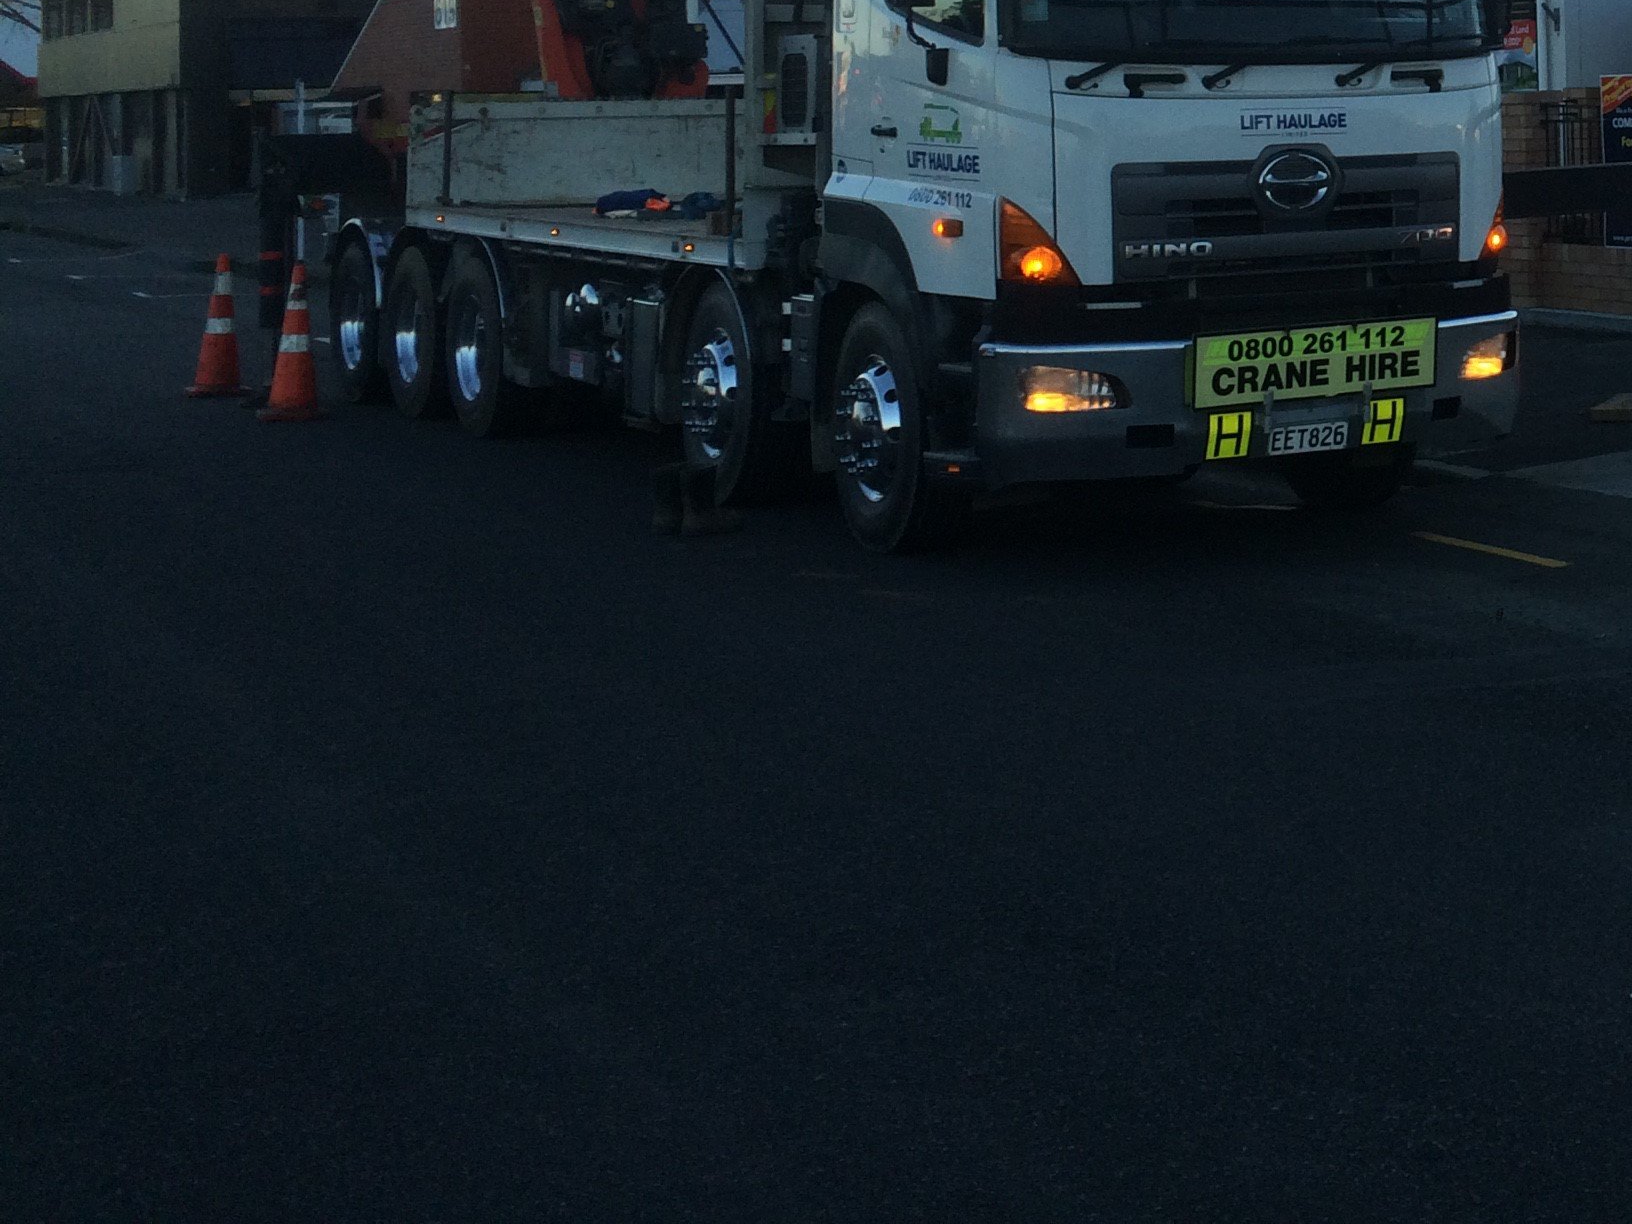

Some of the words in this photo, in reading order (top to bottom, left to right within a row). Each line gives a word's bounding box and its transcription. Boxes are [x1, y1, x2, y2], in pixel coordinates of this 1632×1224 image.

[1240, 114, 1273, 130] LIFT
[1277, 112, 1348, 130] HAULAGE
[907, 150, 927, 170] LIFT
[929, 152, 981, 174] HAULAGE
[933, 189, 953, 206] 261
[954, 192, 973, 209] 112
[1125, 240, 1213, 259] HINO
[1227, 334, 1294, 362] 0800
[1302, 330, 1349, 355] 261
[1359, 325, 1405, 350] 112
[1211, 358, 1331, 397] CRANE
[1345, 349, 1421, 384] HIRE
[1214, 414, 1245, 458] H
[1369, 400, 1398, 443] H
[1272, 424, 1345, 453] EET826
